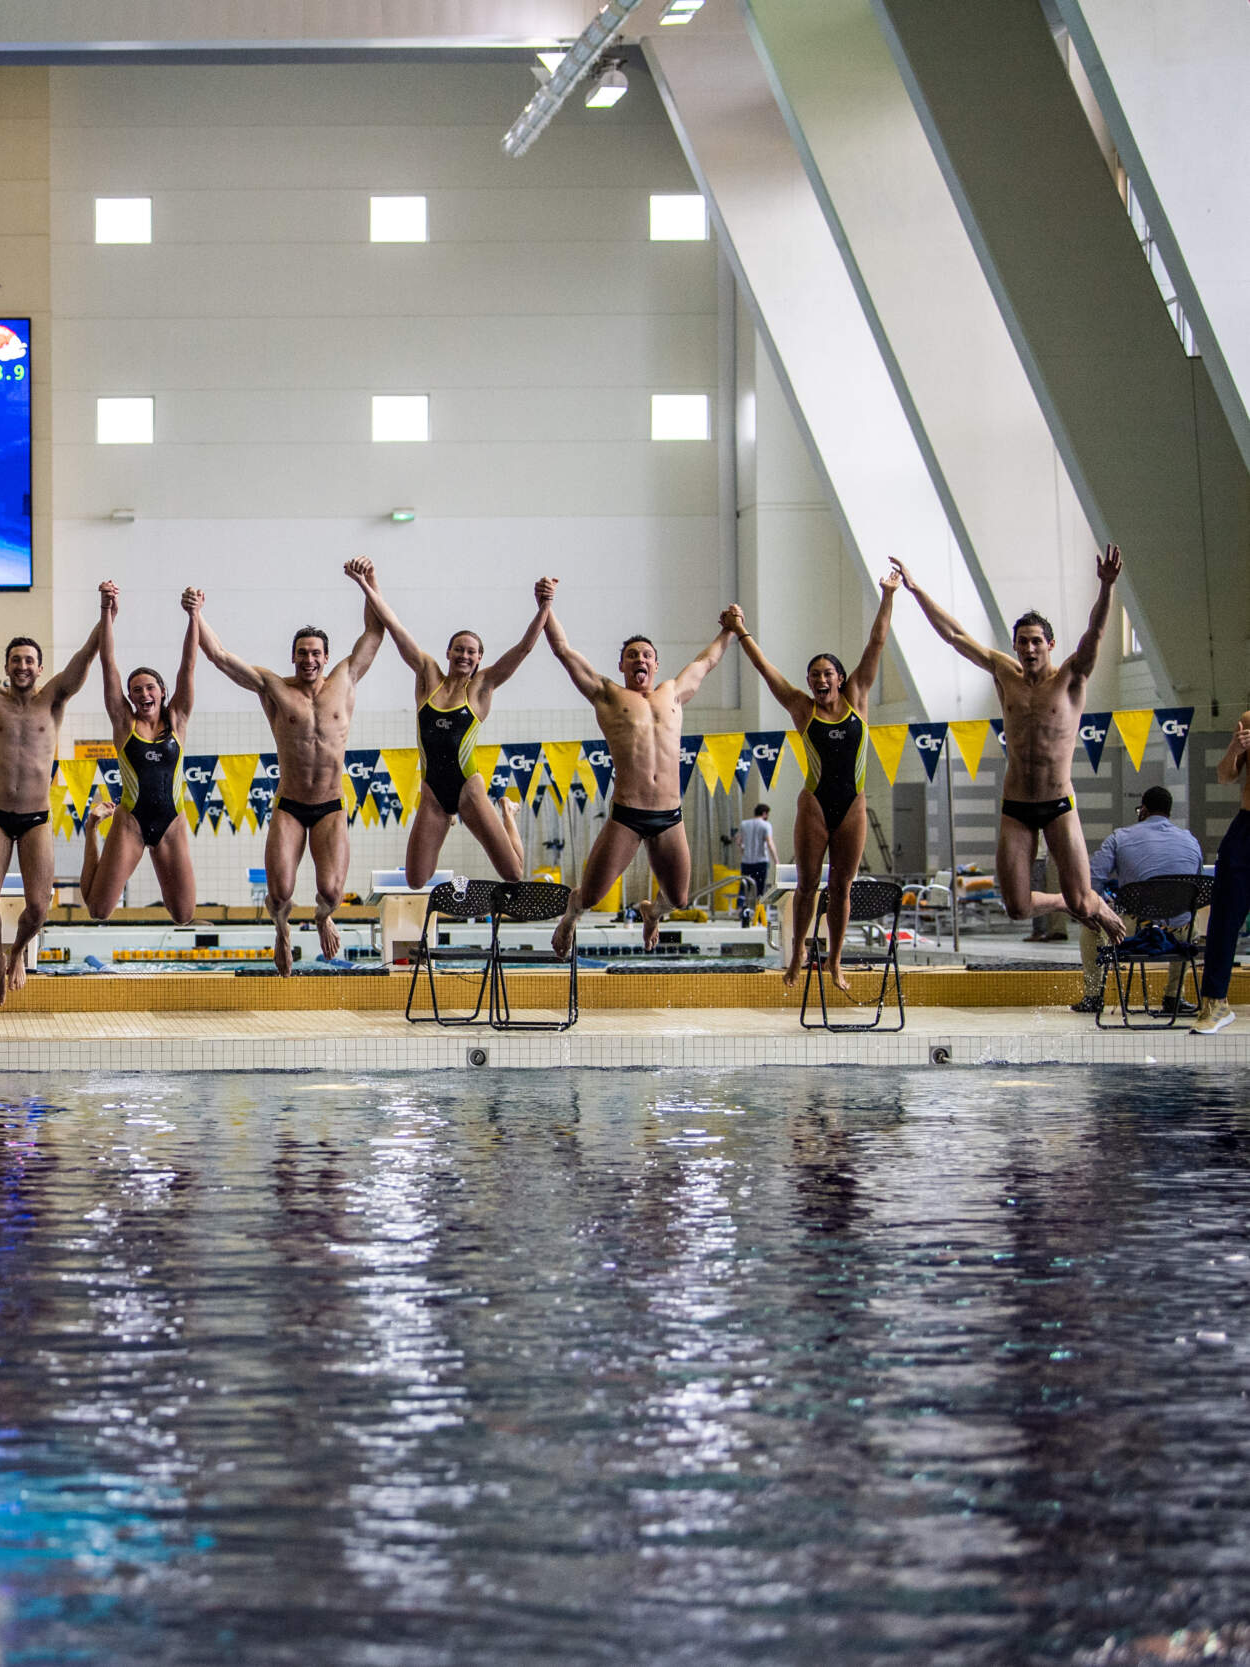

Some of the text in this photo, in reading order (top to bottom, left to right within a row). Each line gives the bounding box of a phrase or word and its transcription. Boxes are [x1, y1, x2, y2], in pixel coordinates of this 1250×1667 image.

[436, 718, 452, 730] GT
[1162, 720, 1188, 737] GT
[829, 729, 846, 739] GT
[1079, 725, 1105, 742] GT
[915, 734, 941, 751] GT
[145, 751, 162, 761] GT
[589, 751, 613, 767] GT
[753, 744, 779, 761] GT
[348, 762, 373, 779] GT
[509, 754, 535, 772] GT
[185, 767, 211, 784] GT
